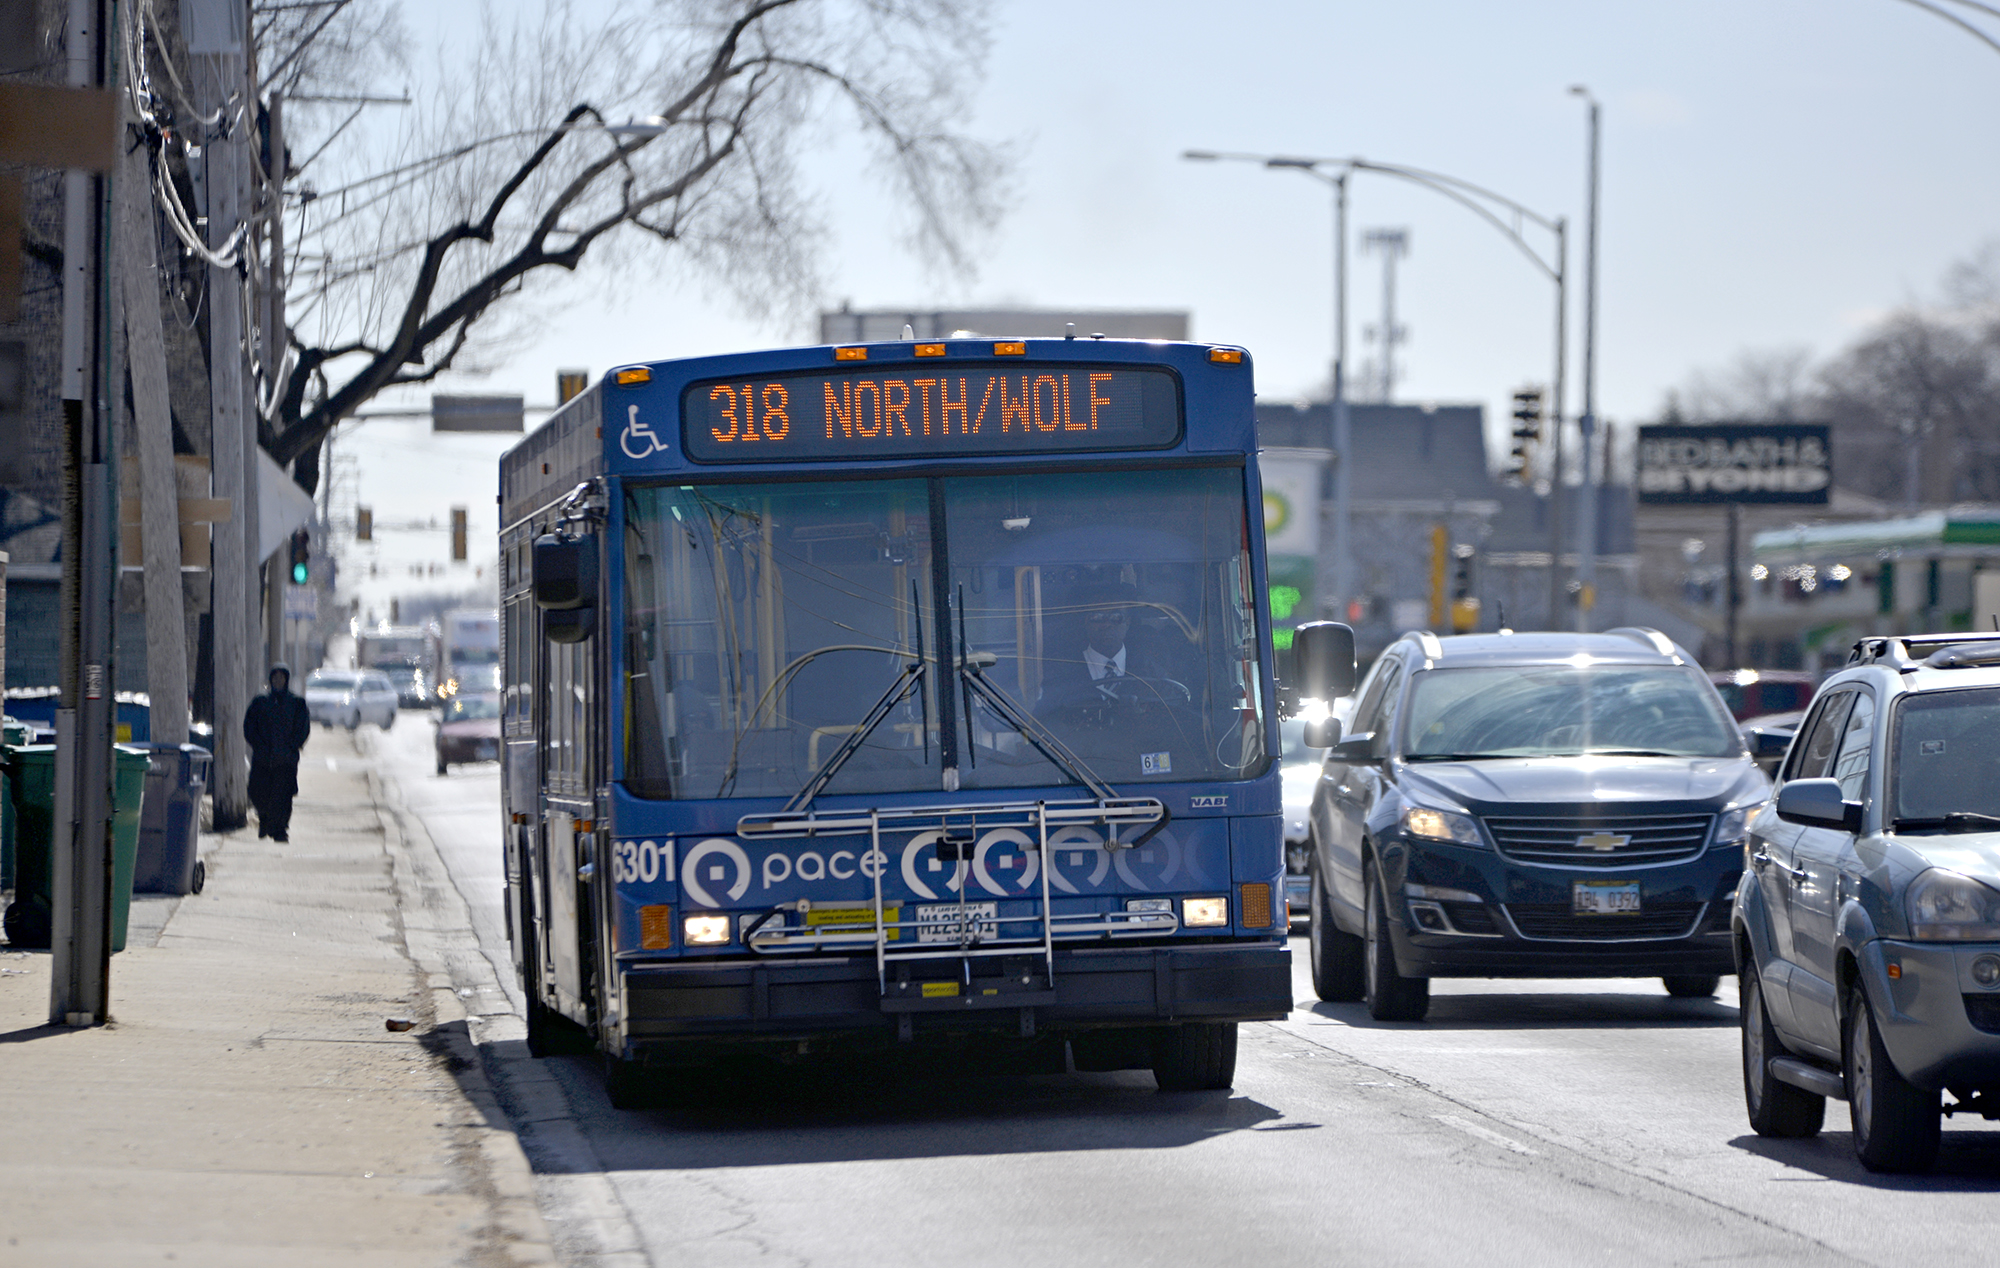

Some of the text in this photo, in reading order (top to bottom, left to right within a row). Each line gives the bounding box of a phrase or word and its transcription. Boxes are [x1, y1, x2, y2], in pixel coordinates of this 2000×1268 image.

[710, 373, 1113, 442] 318 NORTH/WOLF
[1641, 468, 1829, 493] BEYOND
[1144, 756, 1151, 769] 6
[612, 840, 675, 883] 6301
[763, 850, 888, 890] pace
